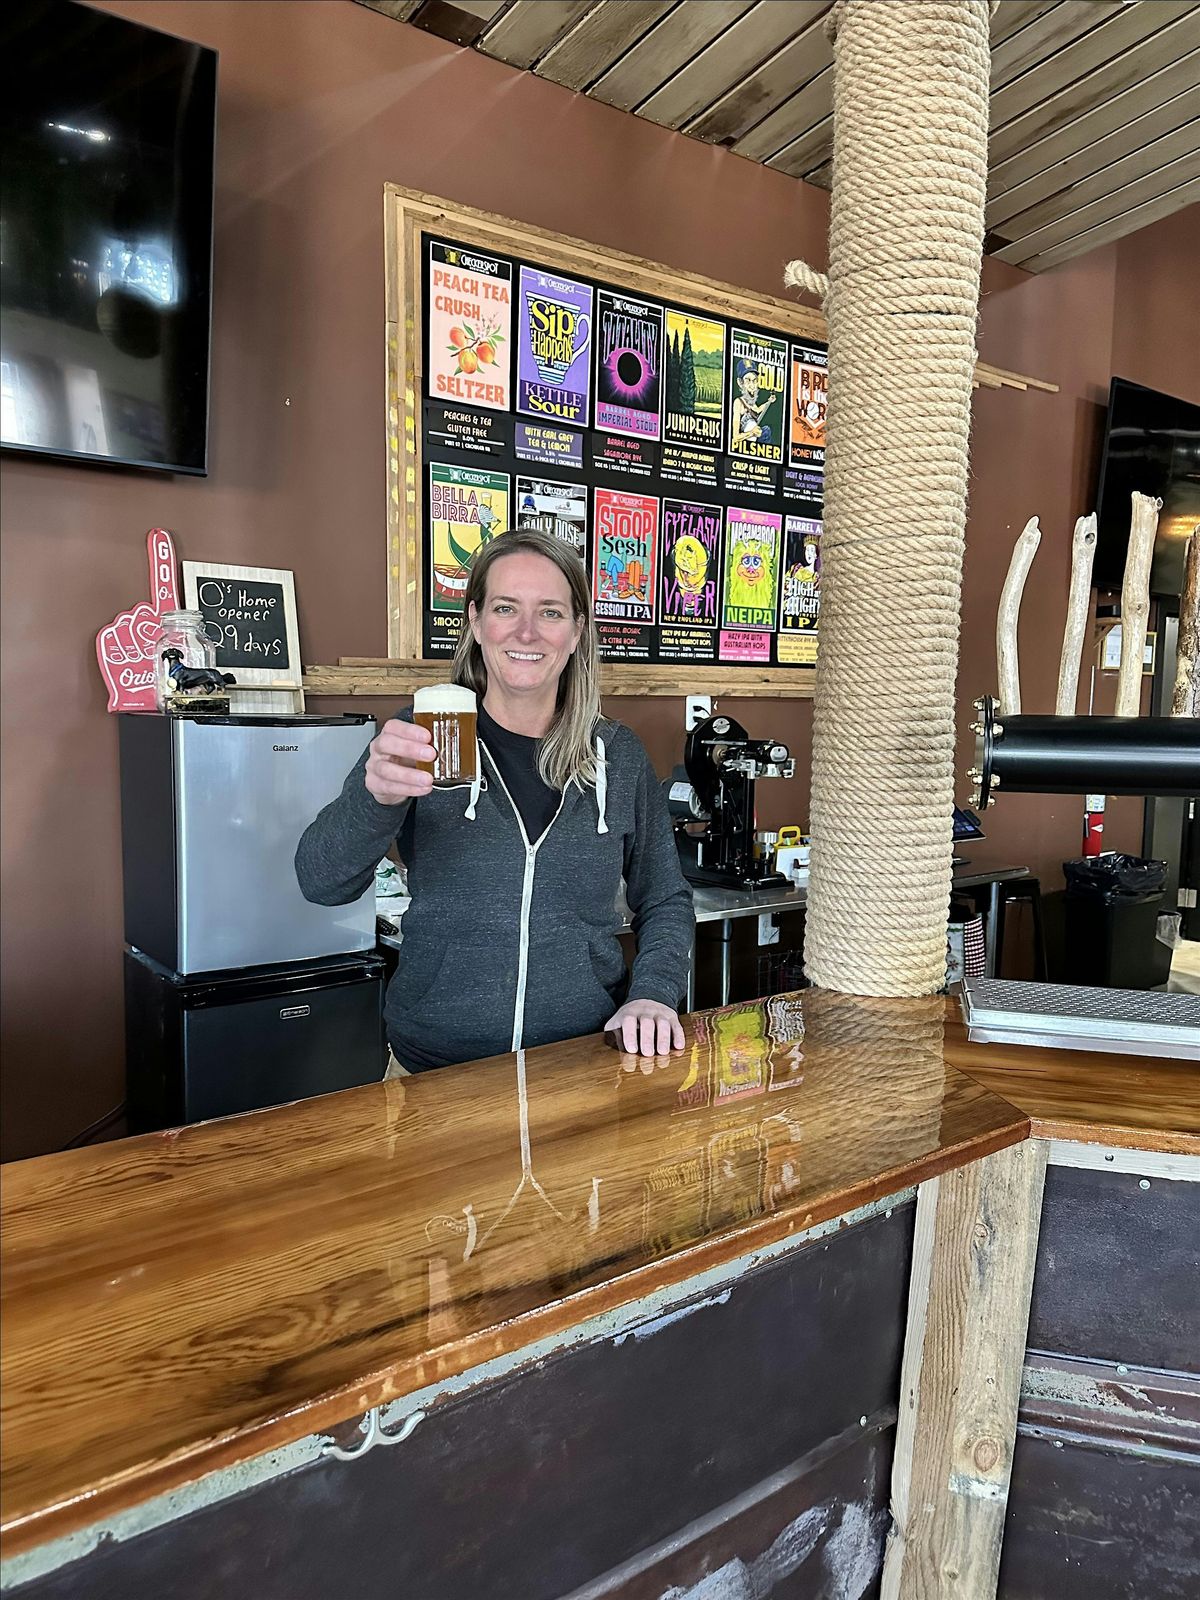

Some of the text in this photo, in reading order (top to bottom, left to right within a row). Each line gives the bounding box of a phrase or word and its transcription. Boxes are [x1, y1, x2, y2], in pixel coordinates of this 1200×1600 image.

[433, 269, 510, 304] PEACH TEA
[435, 295, 480, 321] CRUSH
[532, 300, 574, 341] Sip
[533, 330, 573, 364] Happens
[733, 340, 786, 368] HILLBILLY
[757, 363, 785, 393] GOLD
[436, 374, 505, 406] SELTZER
[525, 382, 582, 408] KETTLE
[528, 394, 580, 419] Sour
[796, 398, 827, 420] WOR
[443, 410, 492, 427] PEACHES & TEA
[598, 412, 657, 433] IMPERIAL STOUT
[665, 412, 721, 438] JUNIPERUS
[447, 424, 488, 438] GLUTEN FREE
[525, 426, 541, 438] WITH
[542, 429, 557, 440] EARL
[528, 437, 541, 448] TEA
[548, 441, 571, 453] LEMON
[731, 438, 781, 460] PILSNER
[792, 447, 812, 459] HONEY
[432, 484, 478, 507] BELLA
[432, 502, 481, 525] BIRRA
[600, 505, 653, 542] STOOP
[555, 517, 580, 549] DOSE
[665, 511, 720, 560] EYELASH
[787, 520, 814, 533] BARREL
[602, 533, 647, 557] Sesh
[199, 582, 276, 608] O's Home
[664, 576, 716, 618] VIPER
[785, 577, 814, 597] HIGH
[218, 608, 270, 621] opener
[595, 602, 652, 619] SESSION IPA
[726, 606, 773, 625] NEIPA
[784, 596, 820, 616] MIGHT
[433, 616, 463, 627] SMOOT
[205, 620, 282, 656] 29 days
[119, 668, 155, 687] Orio
[272, 744, 299, 752] Galanz
